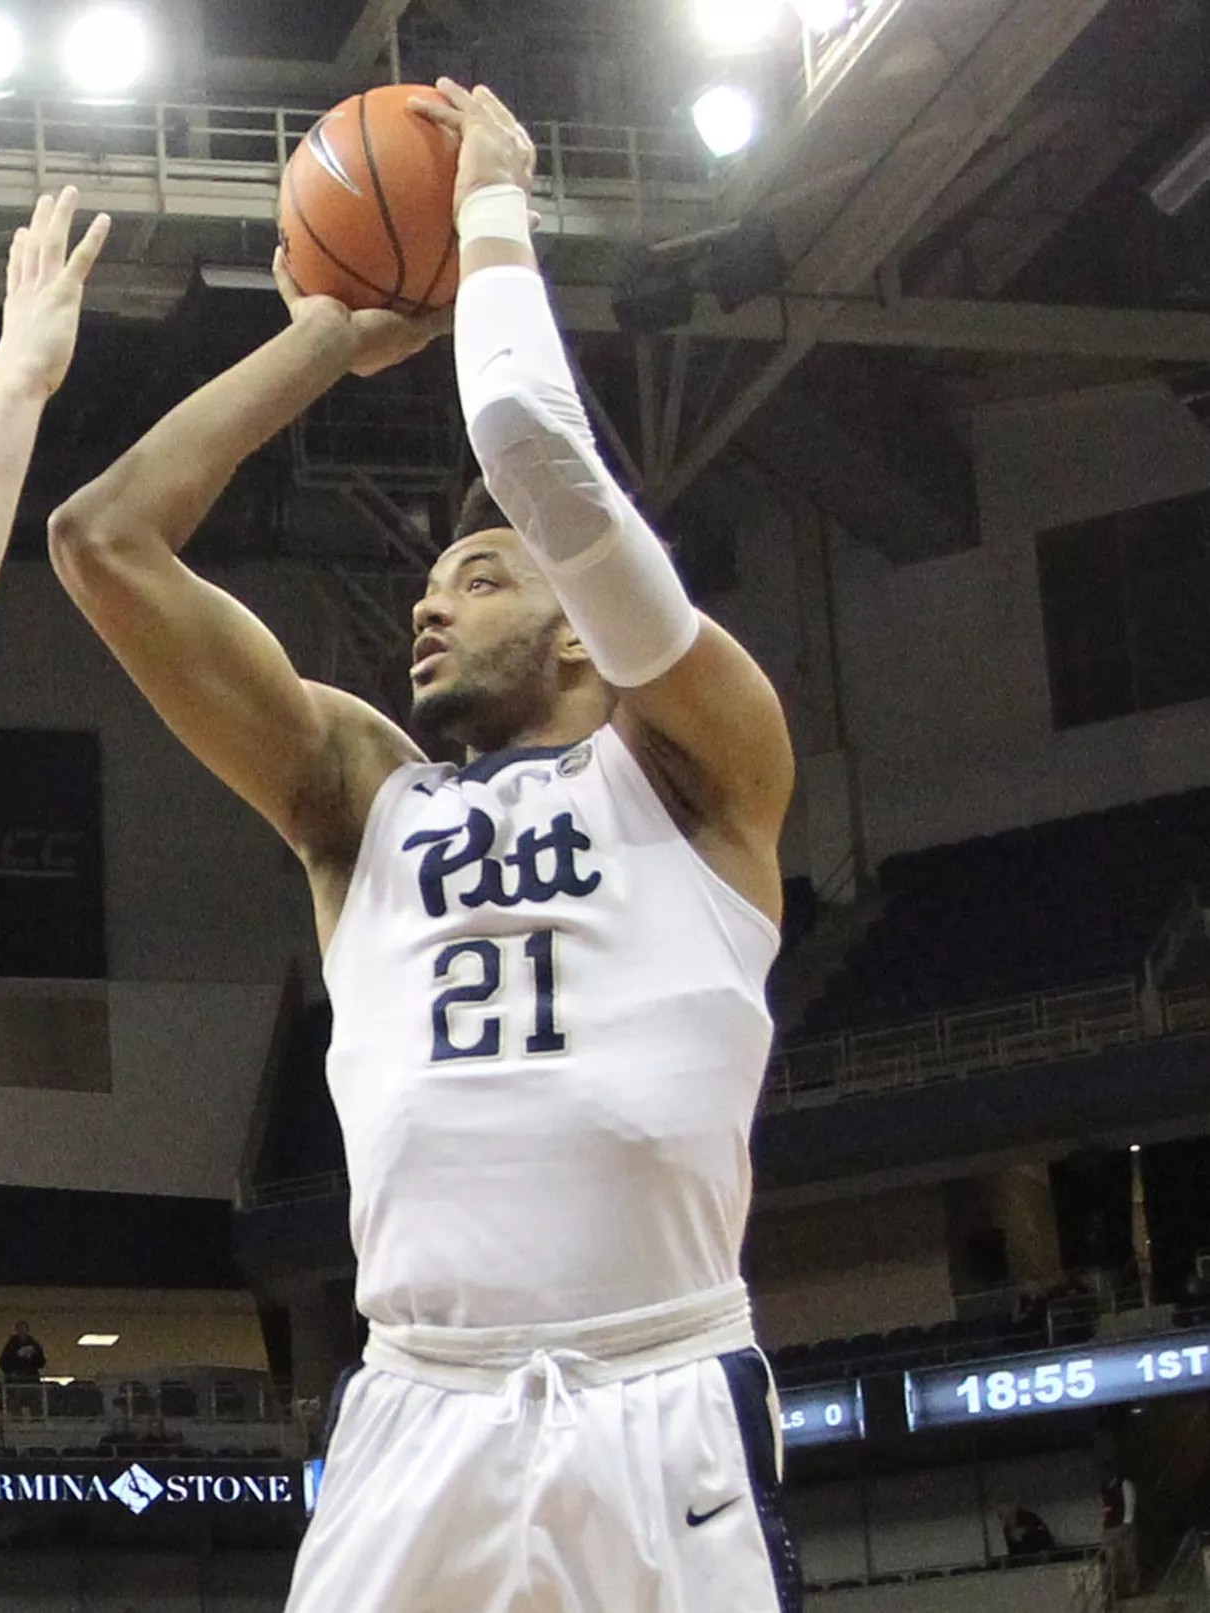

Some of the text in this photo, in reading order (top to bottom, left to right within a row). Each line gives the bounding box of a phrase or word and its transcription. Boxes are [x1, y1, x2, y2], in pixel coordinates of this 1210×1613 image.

[401, 807, 602, 918] Pitt
[428, 929, 568, 1064] 21
[824, 1403, 843, 1427] 0
[956, 1345, 1209, 1415] 18:55 1ST
[166, 1474, 291, 1503] STONE
